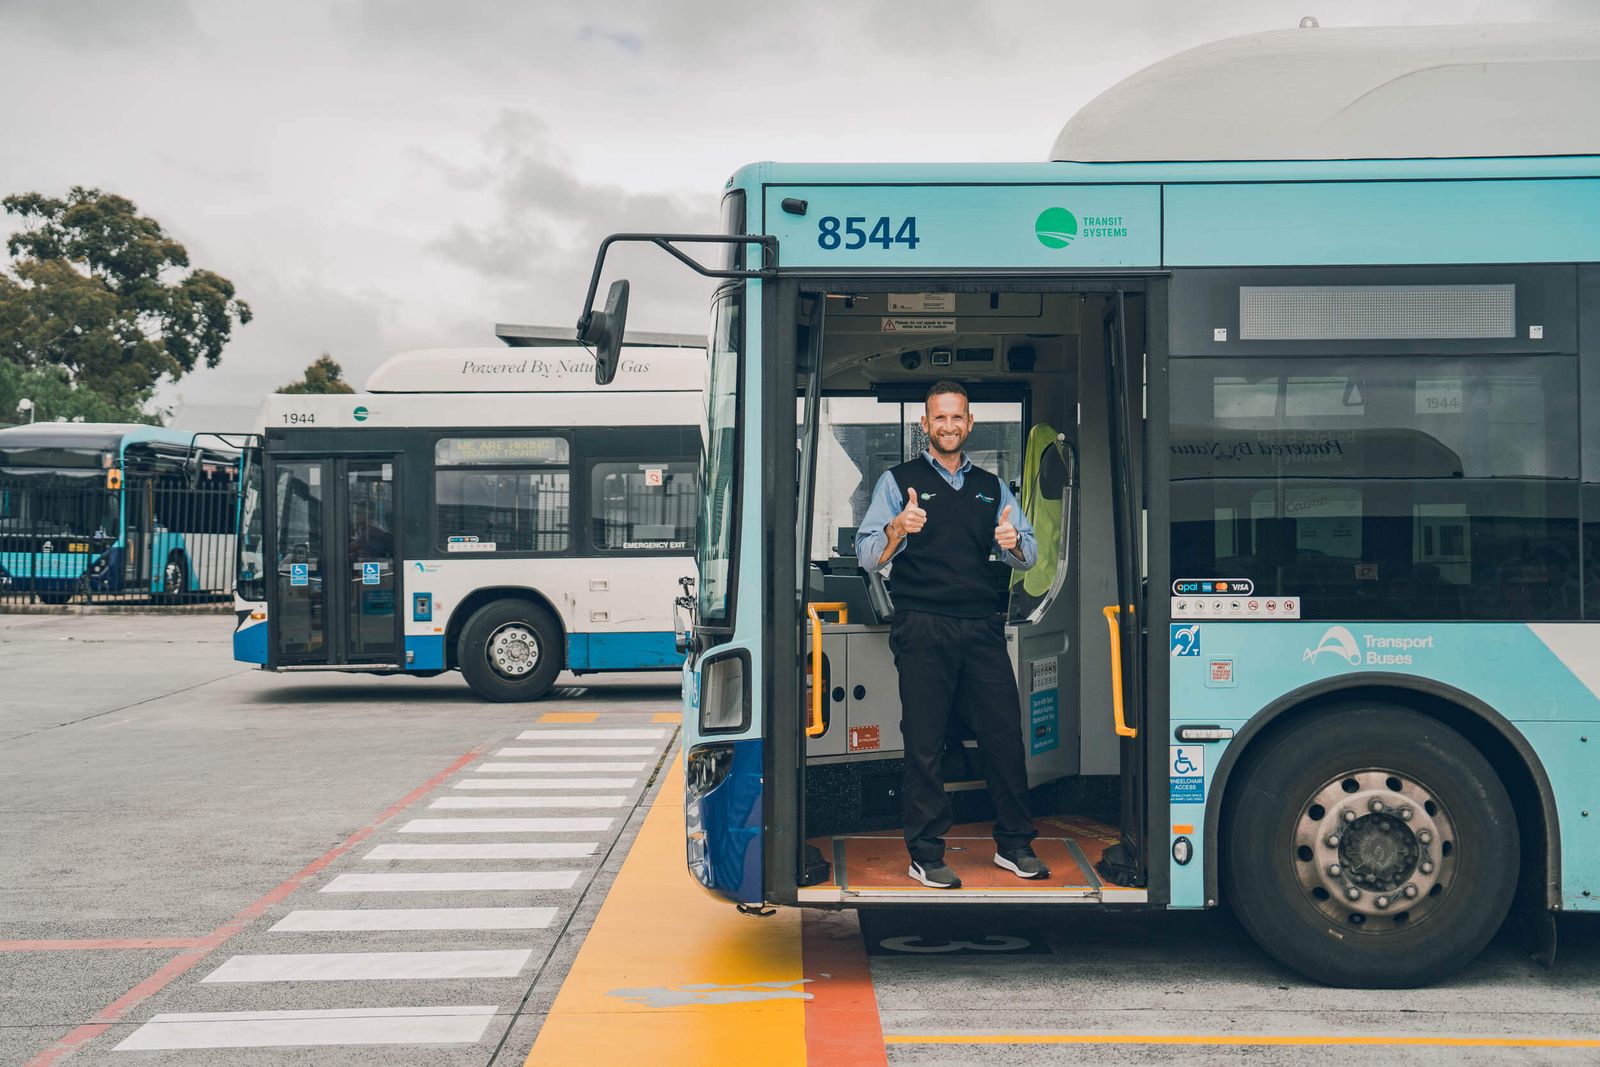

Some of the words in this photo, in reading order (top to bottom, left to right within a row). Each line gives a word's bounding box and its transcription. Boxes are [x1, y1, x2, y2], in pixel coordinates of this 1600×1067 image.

[1083, 217, 1123, 226] TRANSIT
[818, 216, 920, 250] 8544
[1083, 228, 1127, 237] SYSTEMS
[461, 360, 528, 375] Powered
[530, 360, 551, 378] By
[556, 360, 595, 378] Natu
[620, 359, 650, 374] Gas
[282, 413, 315, 424] 1944
[1177, 583, 1198, 592] opal
[1231, 583, 1249, 591] VISA
[1363, 635, 1433, 650] Transport
[1366, 652, 1413, 665] Buses
